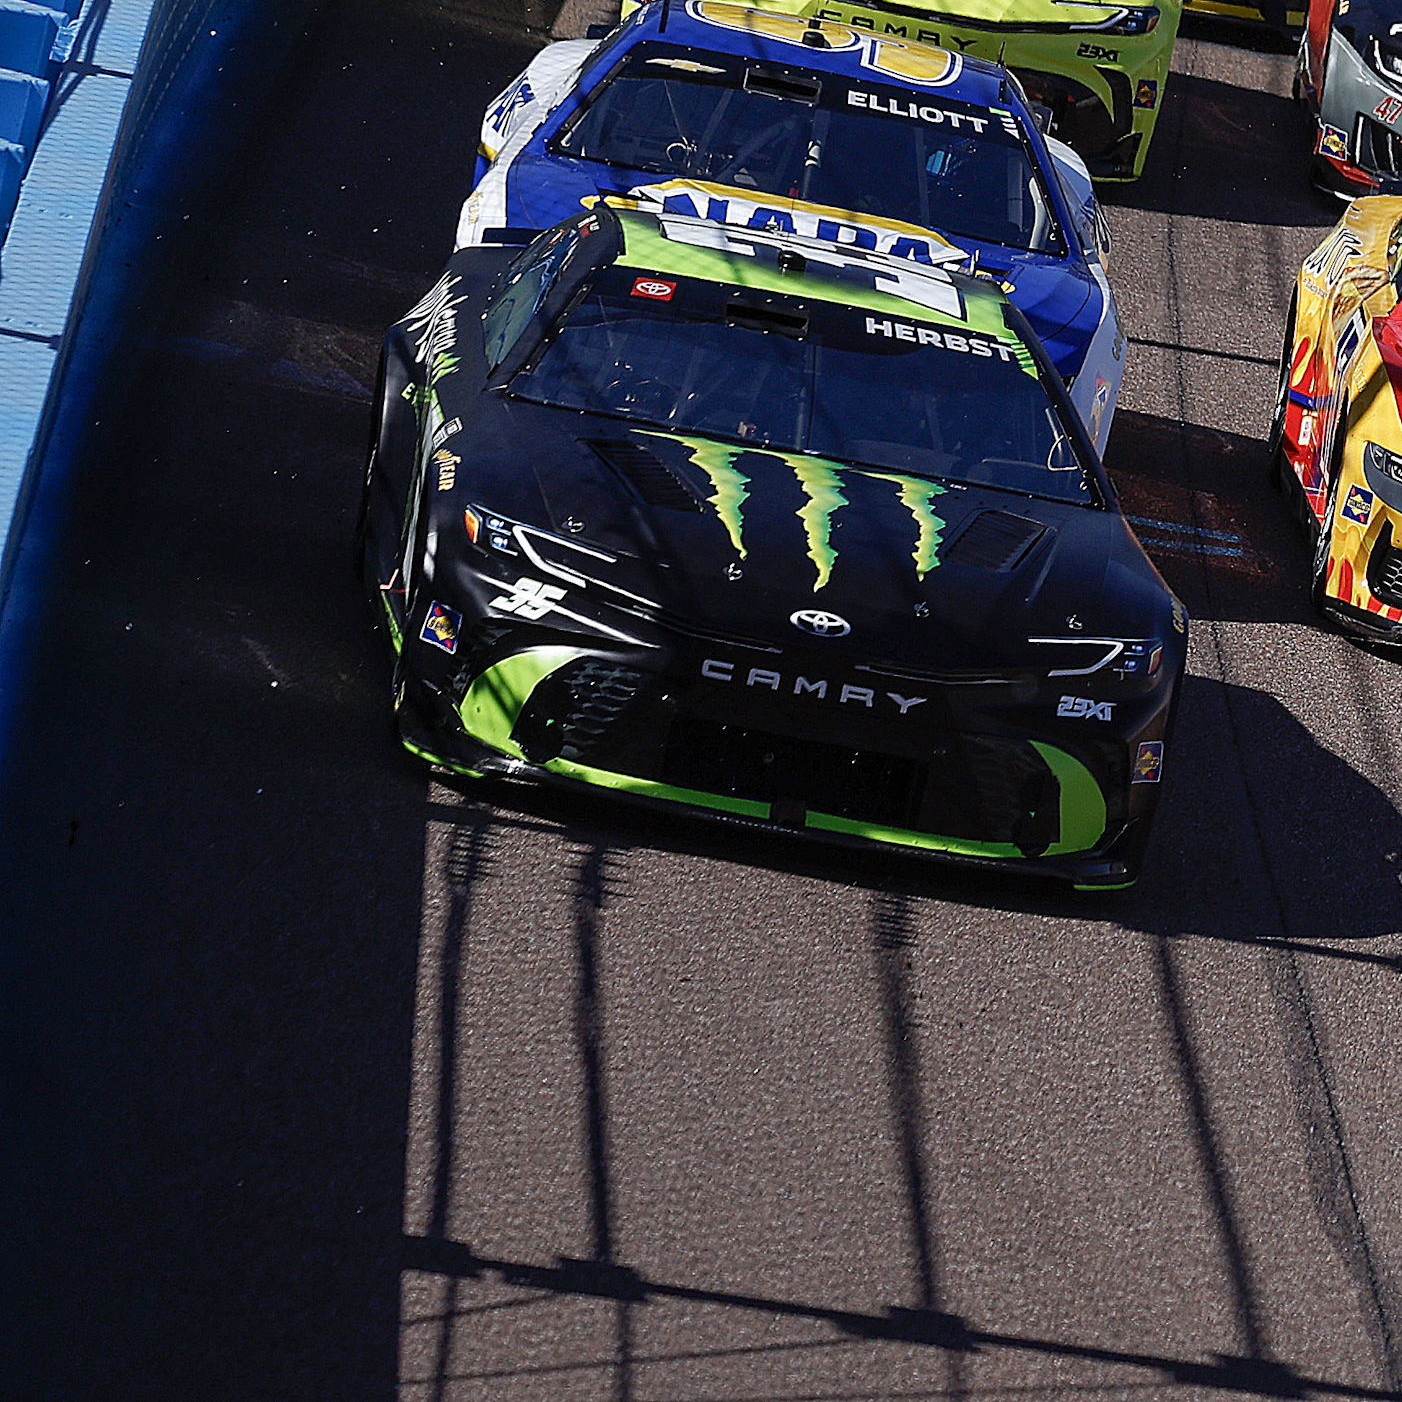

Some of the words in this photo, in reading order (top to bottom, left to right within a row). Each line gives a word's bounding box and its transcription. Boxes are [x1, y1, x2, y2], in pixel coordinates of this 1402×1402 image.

[820, 8, 979, 53] CAMRY
[847, 89, 989, 135] ELLIOTT
[865, 316, 1015, 363] HERBST
[488, 576, 569, 621] 35
[699, 657, 930, 717] CAMRY
